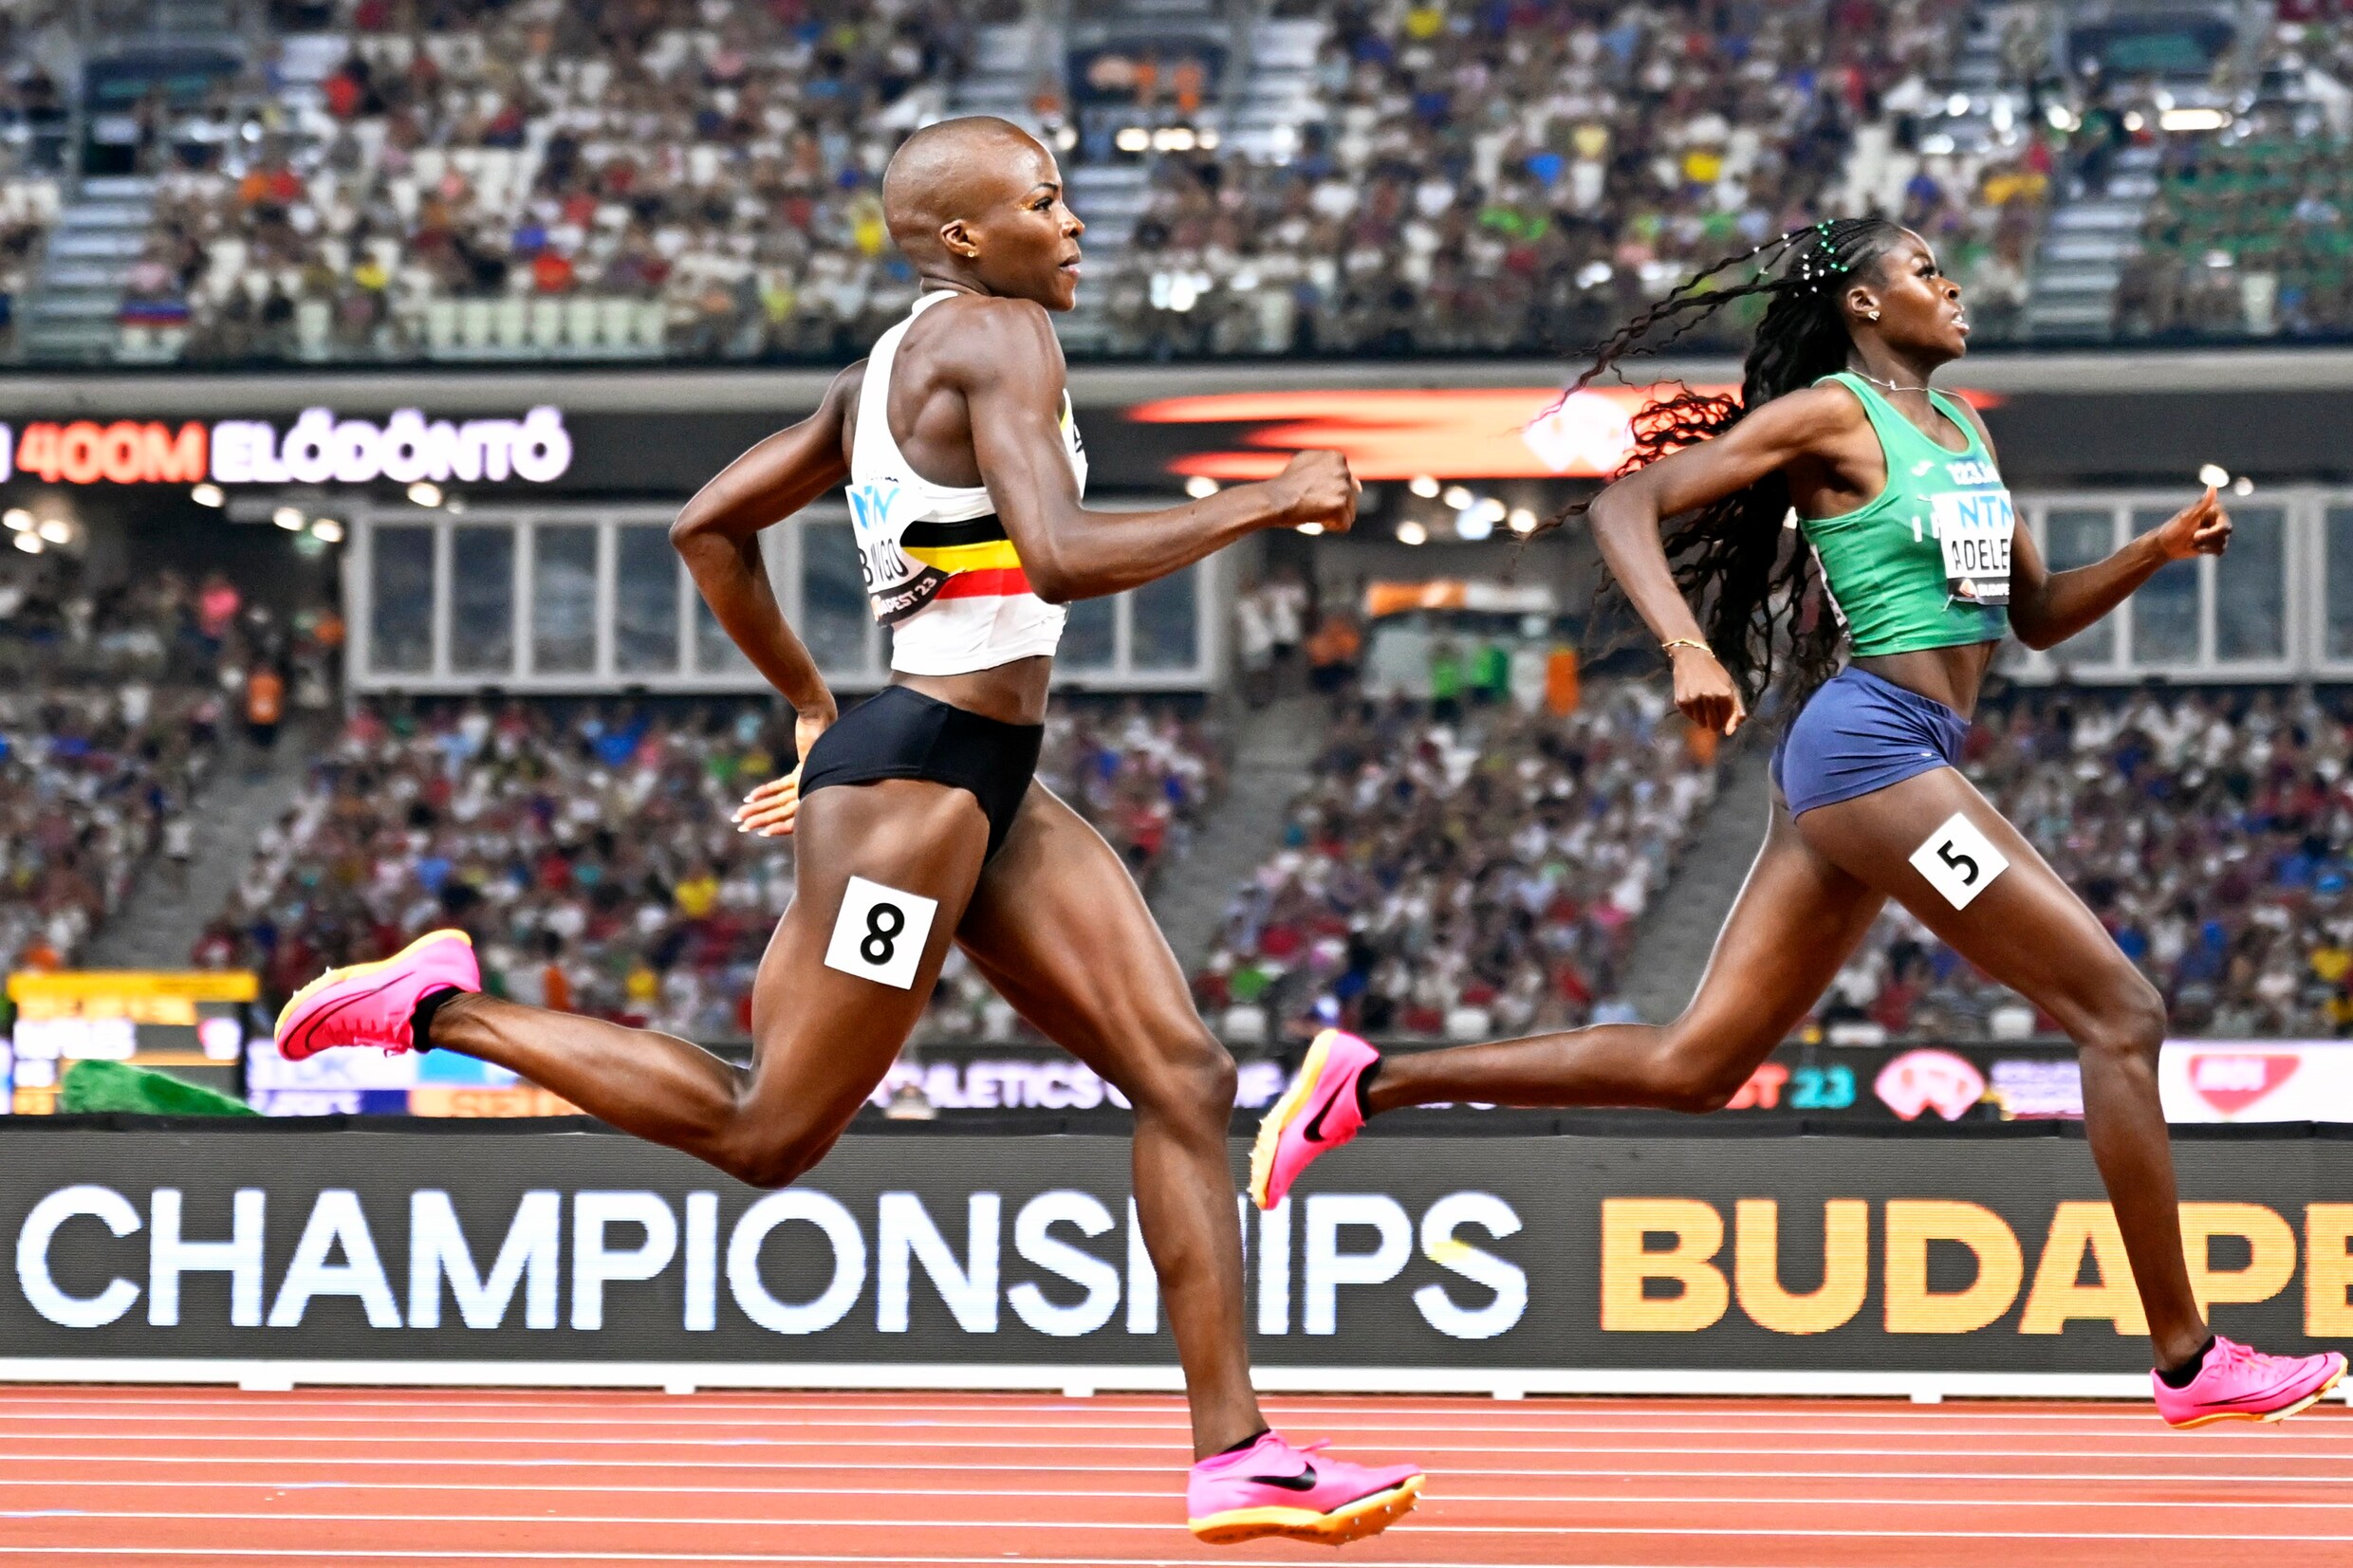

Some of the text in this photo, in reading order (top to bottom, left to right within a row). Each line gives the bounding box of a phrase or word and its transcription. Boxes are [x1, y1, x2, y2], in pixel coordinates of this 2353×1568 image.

[16, 420, 209, 483] 400M
[914, 577, 936, 597] 23
[1936, 839, 1979, 887] 5
[860, 902, 905, 966] 8
